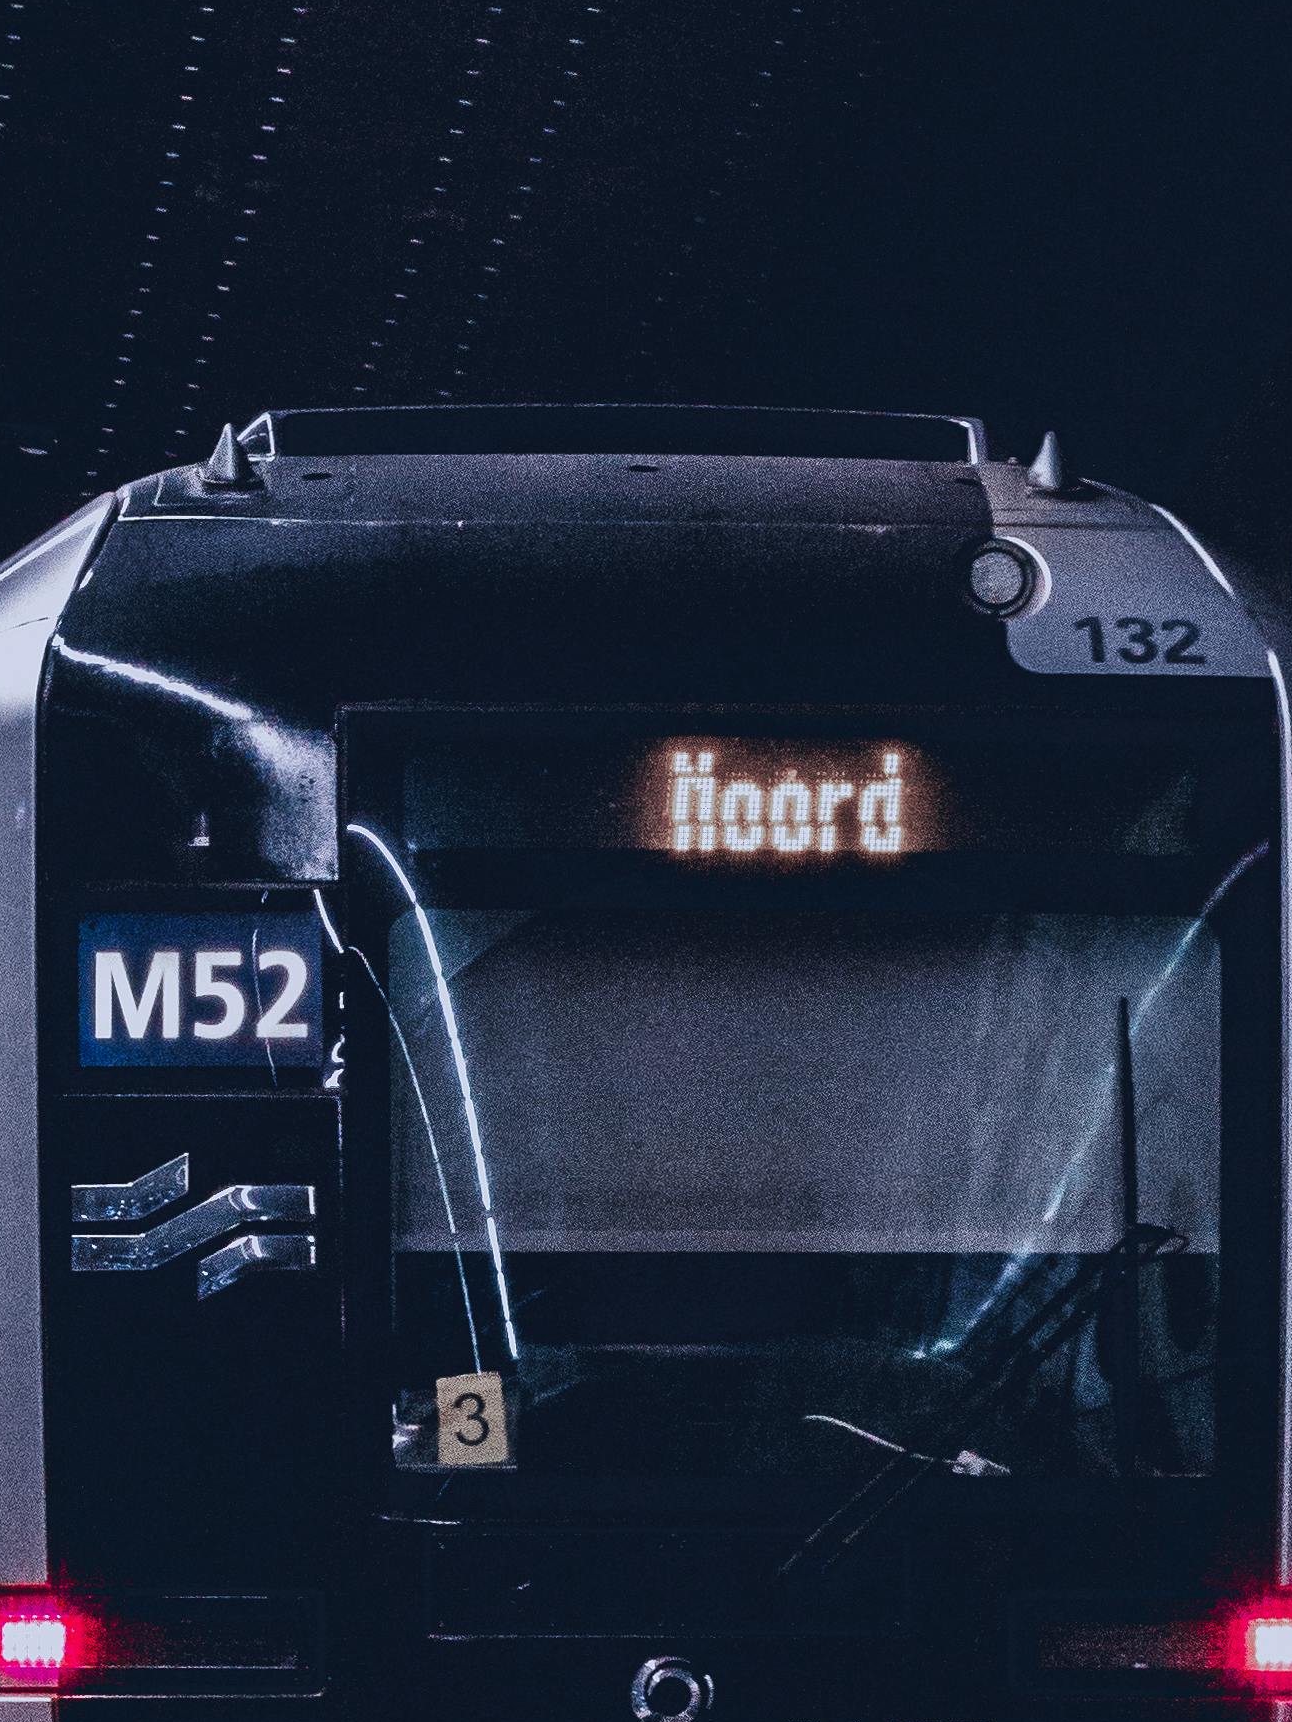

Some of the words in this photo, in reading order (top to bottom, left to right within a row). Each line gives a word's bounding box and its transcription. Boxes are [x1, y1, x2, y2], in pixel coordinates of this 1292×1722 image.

[1075, 616, 1206, 666] 132
[672, 751, 902, 853] Noord
[94, 949, 309, 1041] M52
[453, 1392, 491, 1447] 3
